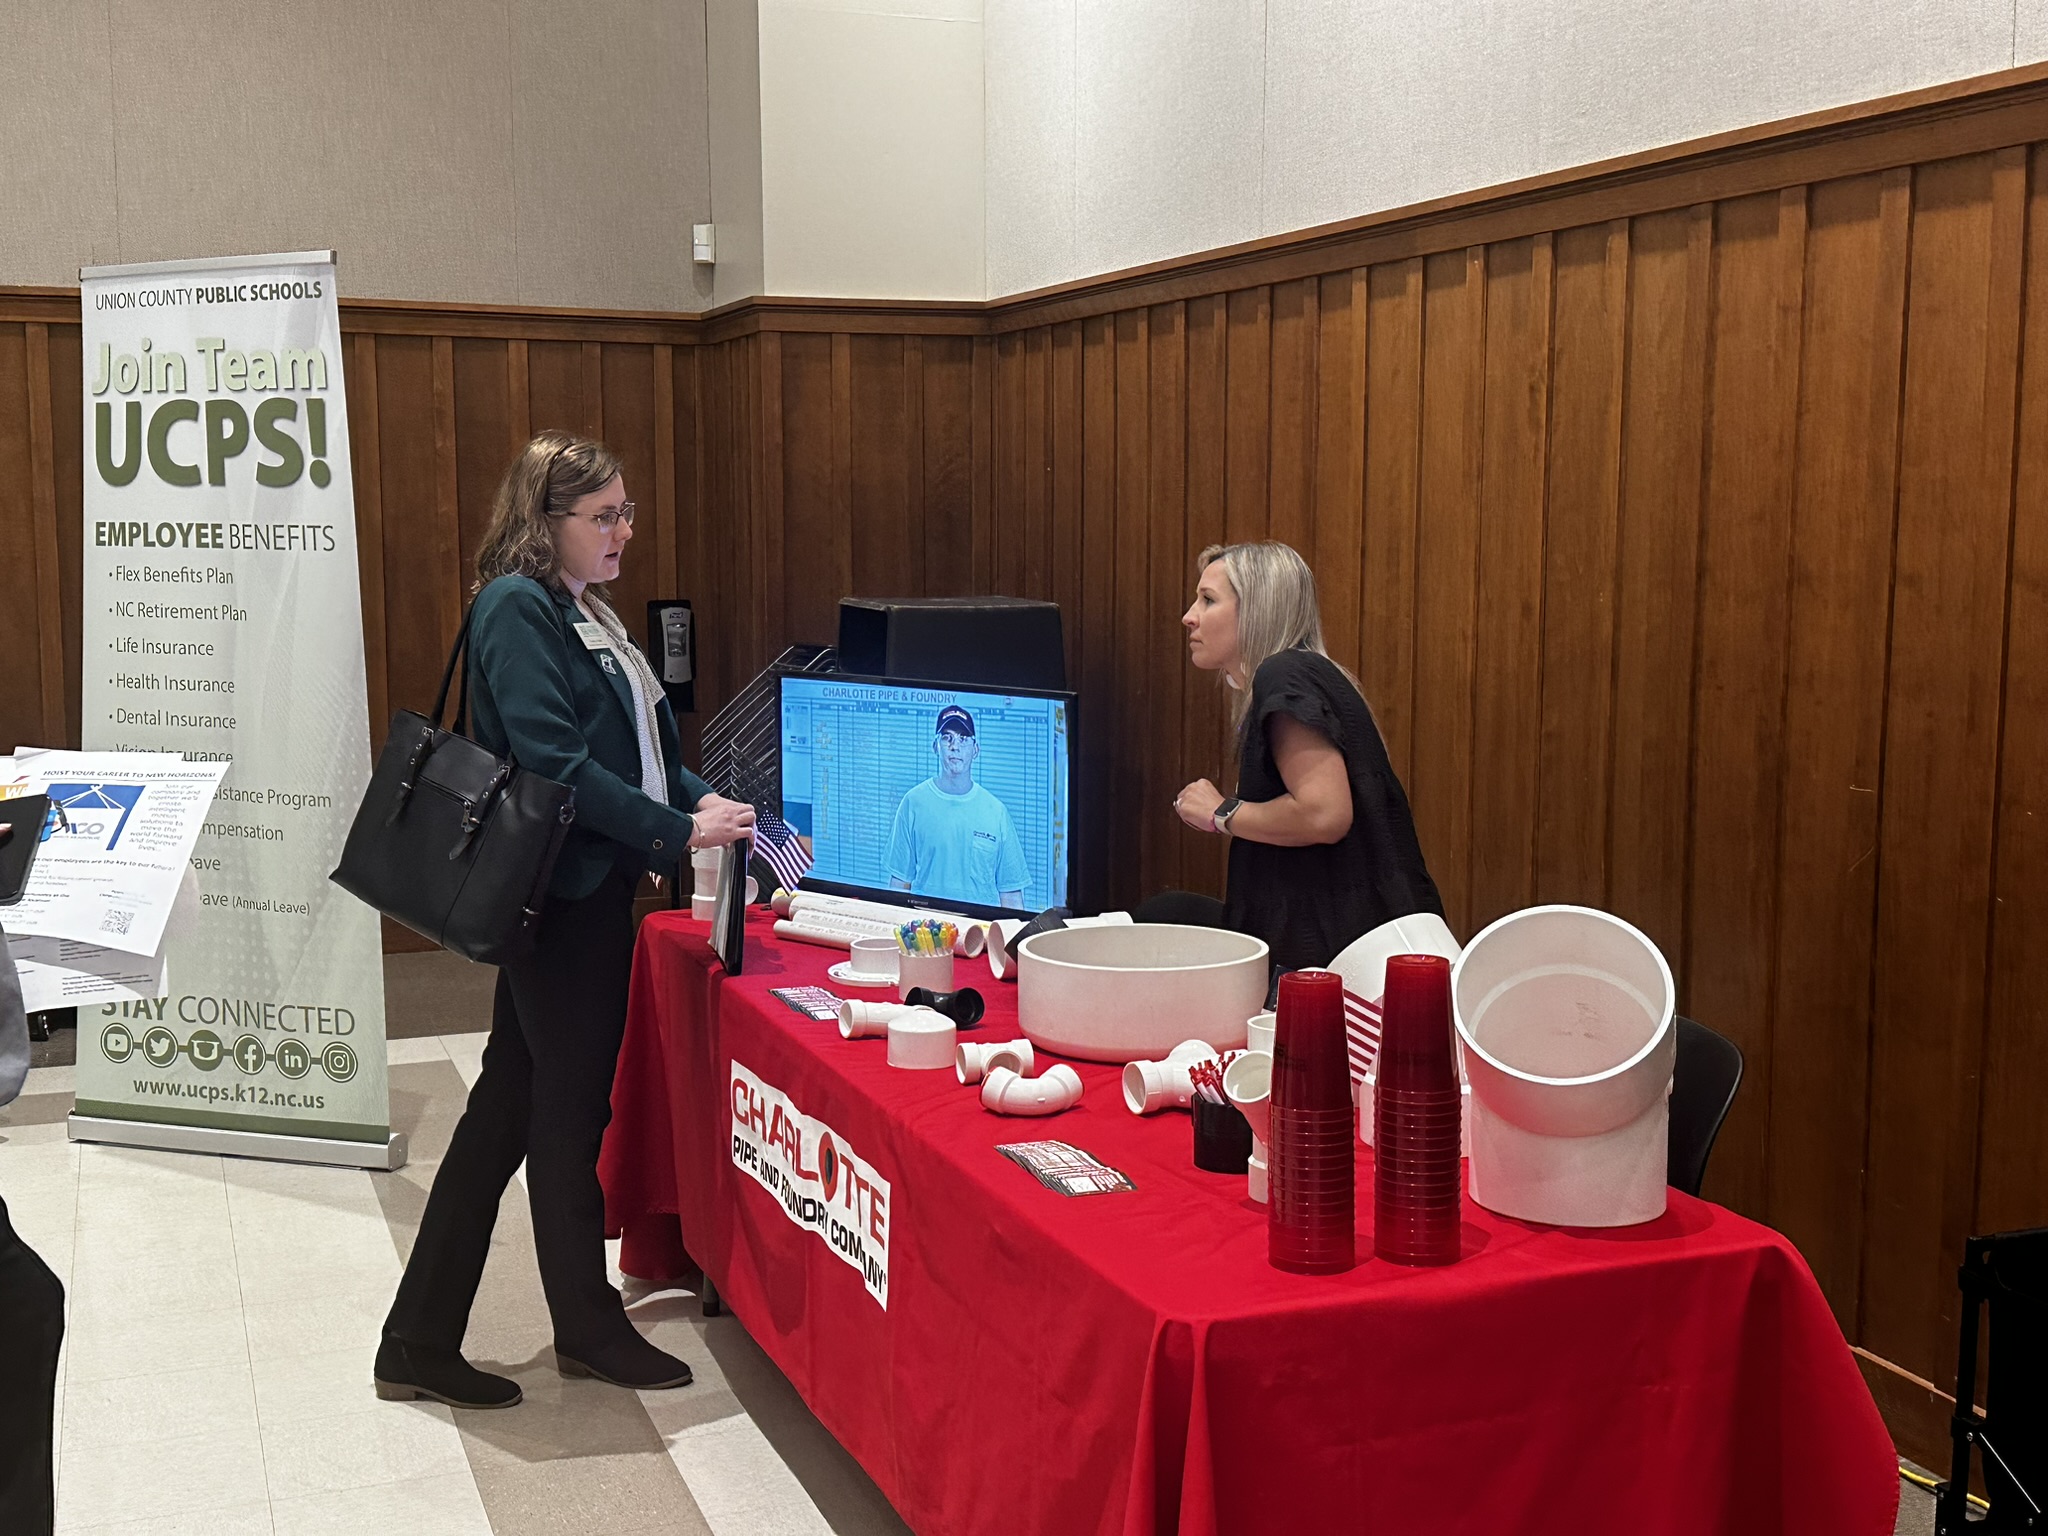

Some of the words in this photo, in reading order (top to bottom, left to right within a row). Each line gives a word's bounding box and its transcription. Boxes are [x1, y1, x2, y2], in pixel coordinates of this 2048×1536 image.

[96, 292, 136, 310] UNION
[139, 288, 193, 308] COUNTY
[196, 284, 247, 304] PUBLIC
[250, 281, 322, 301] SCHOOLS
[92, 337, 187, 395] Join
[196, 337, 328, 392] Team
[95, 397, 332, 489] UCPS!
[95, 522, 224, 549] EMPLOYEE
[230, 524, 336, 552] BENEFITS
[116, 565, 140, 582] Flex
[144, 566, 203, 584] Benefits
[206, 568, 234, 585] Plan
[116, 602, 134, 618] NC
[138, 602, 218, 621] Retirement
[222, 605, 247, 622] Plan
[116, 637, 138, 654] Life
[142, 638, 214, 657] Insurance
[116, 672, 160, 690] Health
[164, 675, 235, 694] Insurance
[822, 686, 876, 700] CHARLOTTE
[878, 690, 899, 701] PIPE
[901, 692, 908, 701] &
[910, 692, 958, 704] FOUNDRY
[116, 708, 160, 726] Dental
[166, 710, 236, 729] Insurance
[161, 746, 234, 762] Iurance
[213, 785, 264, 804] sistance
[268, 788, 332, 810] Program
[202, 822, 284, 841] mpensation
[191, 856, 221, 871] ave
[200, 893, 228, 907] ave
[232, 896, 270, 912] (Annual
[273, 900, 310, 916] Leave)
[101, 997, 168, 1021] STAY
[178, 996, 356, 1036] CONNECTED
[133, 1079, 325, 1110] www.ucps.k12.nc.us
[732, 1077, 886, 1250] CHARLOTTE
[733, 1134, 758, 1172] PIPE
[760, 1158, 780, 1190] AND
[831, 1218, 884, 1294] COMNY
